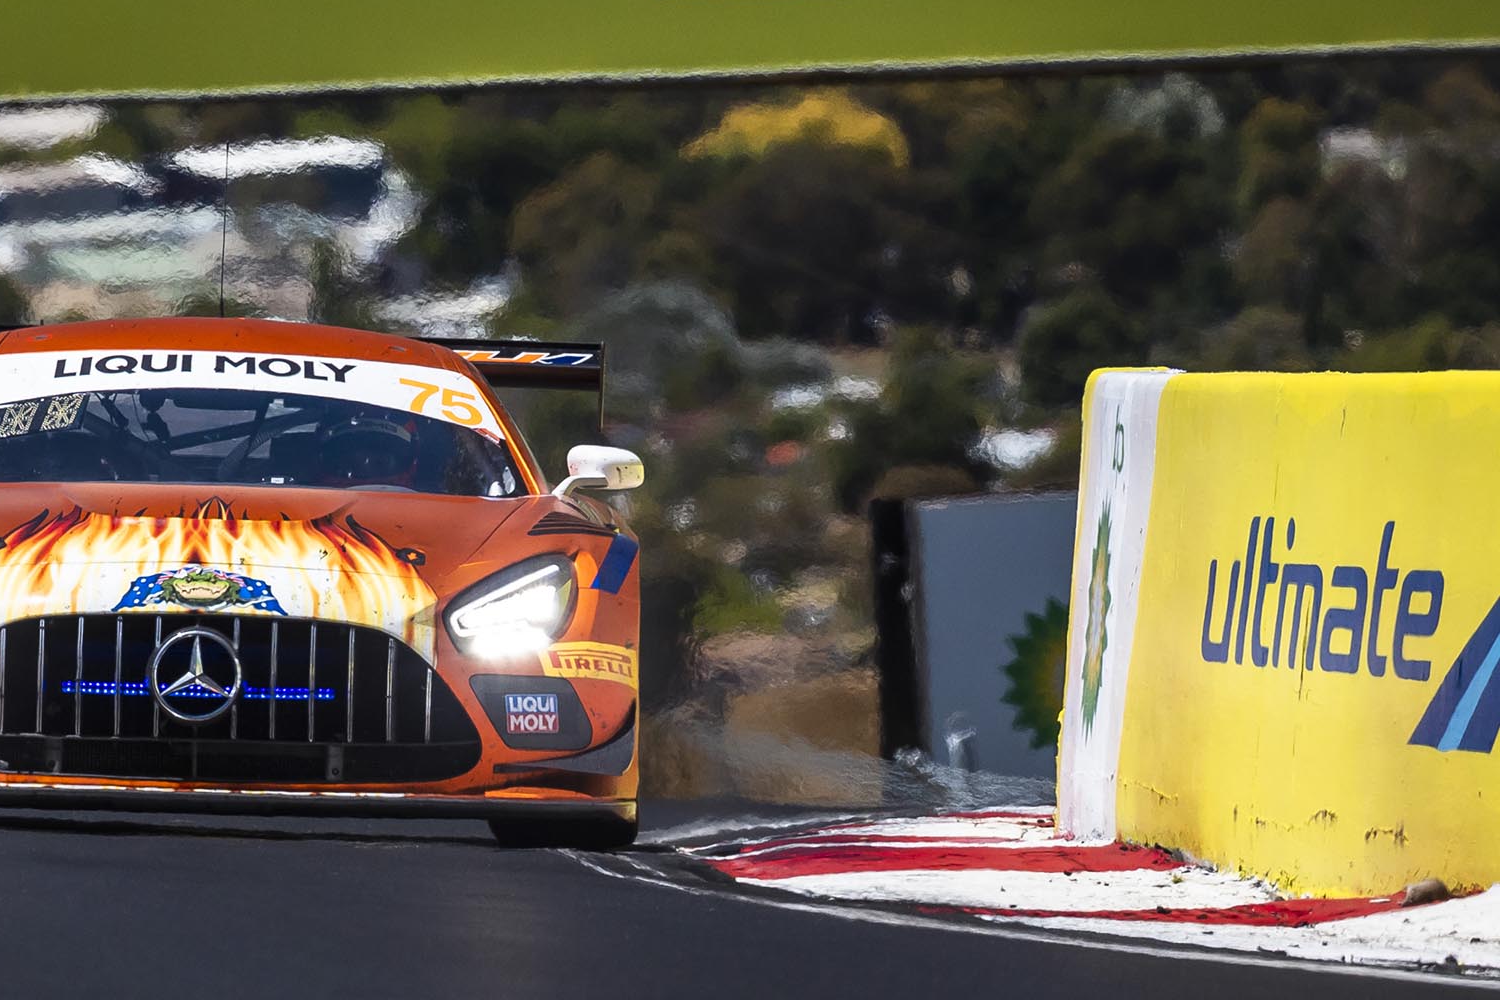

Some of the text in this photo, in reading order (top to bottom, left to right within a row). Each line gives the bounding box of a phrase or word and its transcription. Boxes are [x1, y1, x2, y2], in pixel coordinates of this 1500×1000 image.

[53, 353, 357, 383] LIQUI MOLY
[399, 378, 483, 427] 75
[1201, 516, 1445, 682] ultimate
[547, 649, 632, 678] PIRELLI
[508, 695, 555, 713] LIQUI
[509, 714, 556, 732] MOLY
